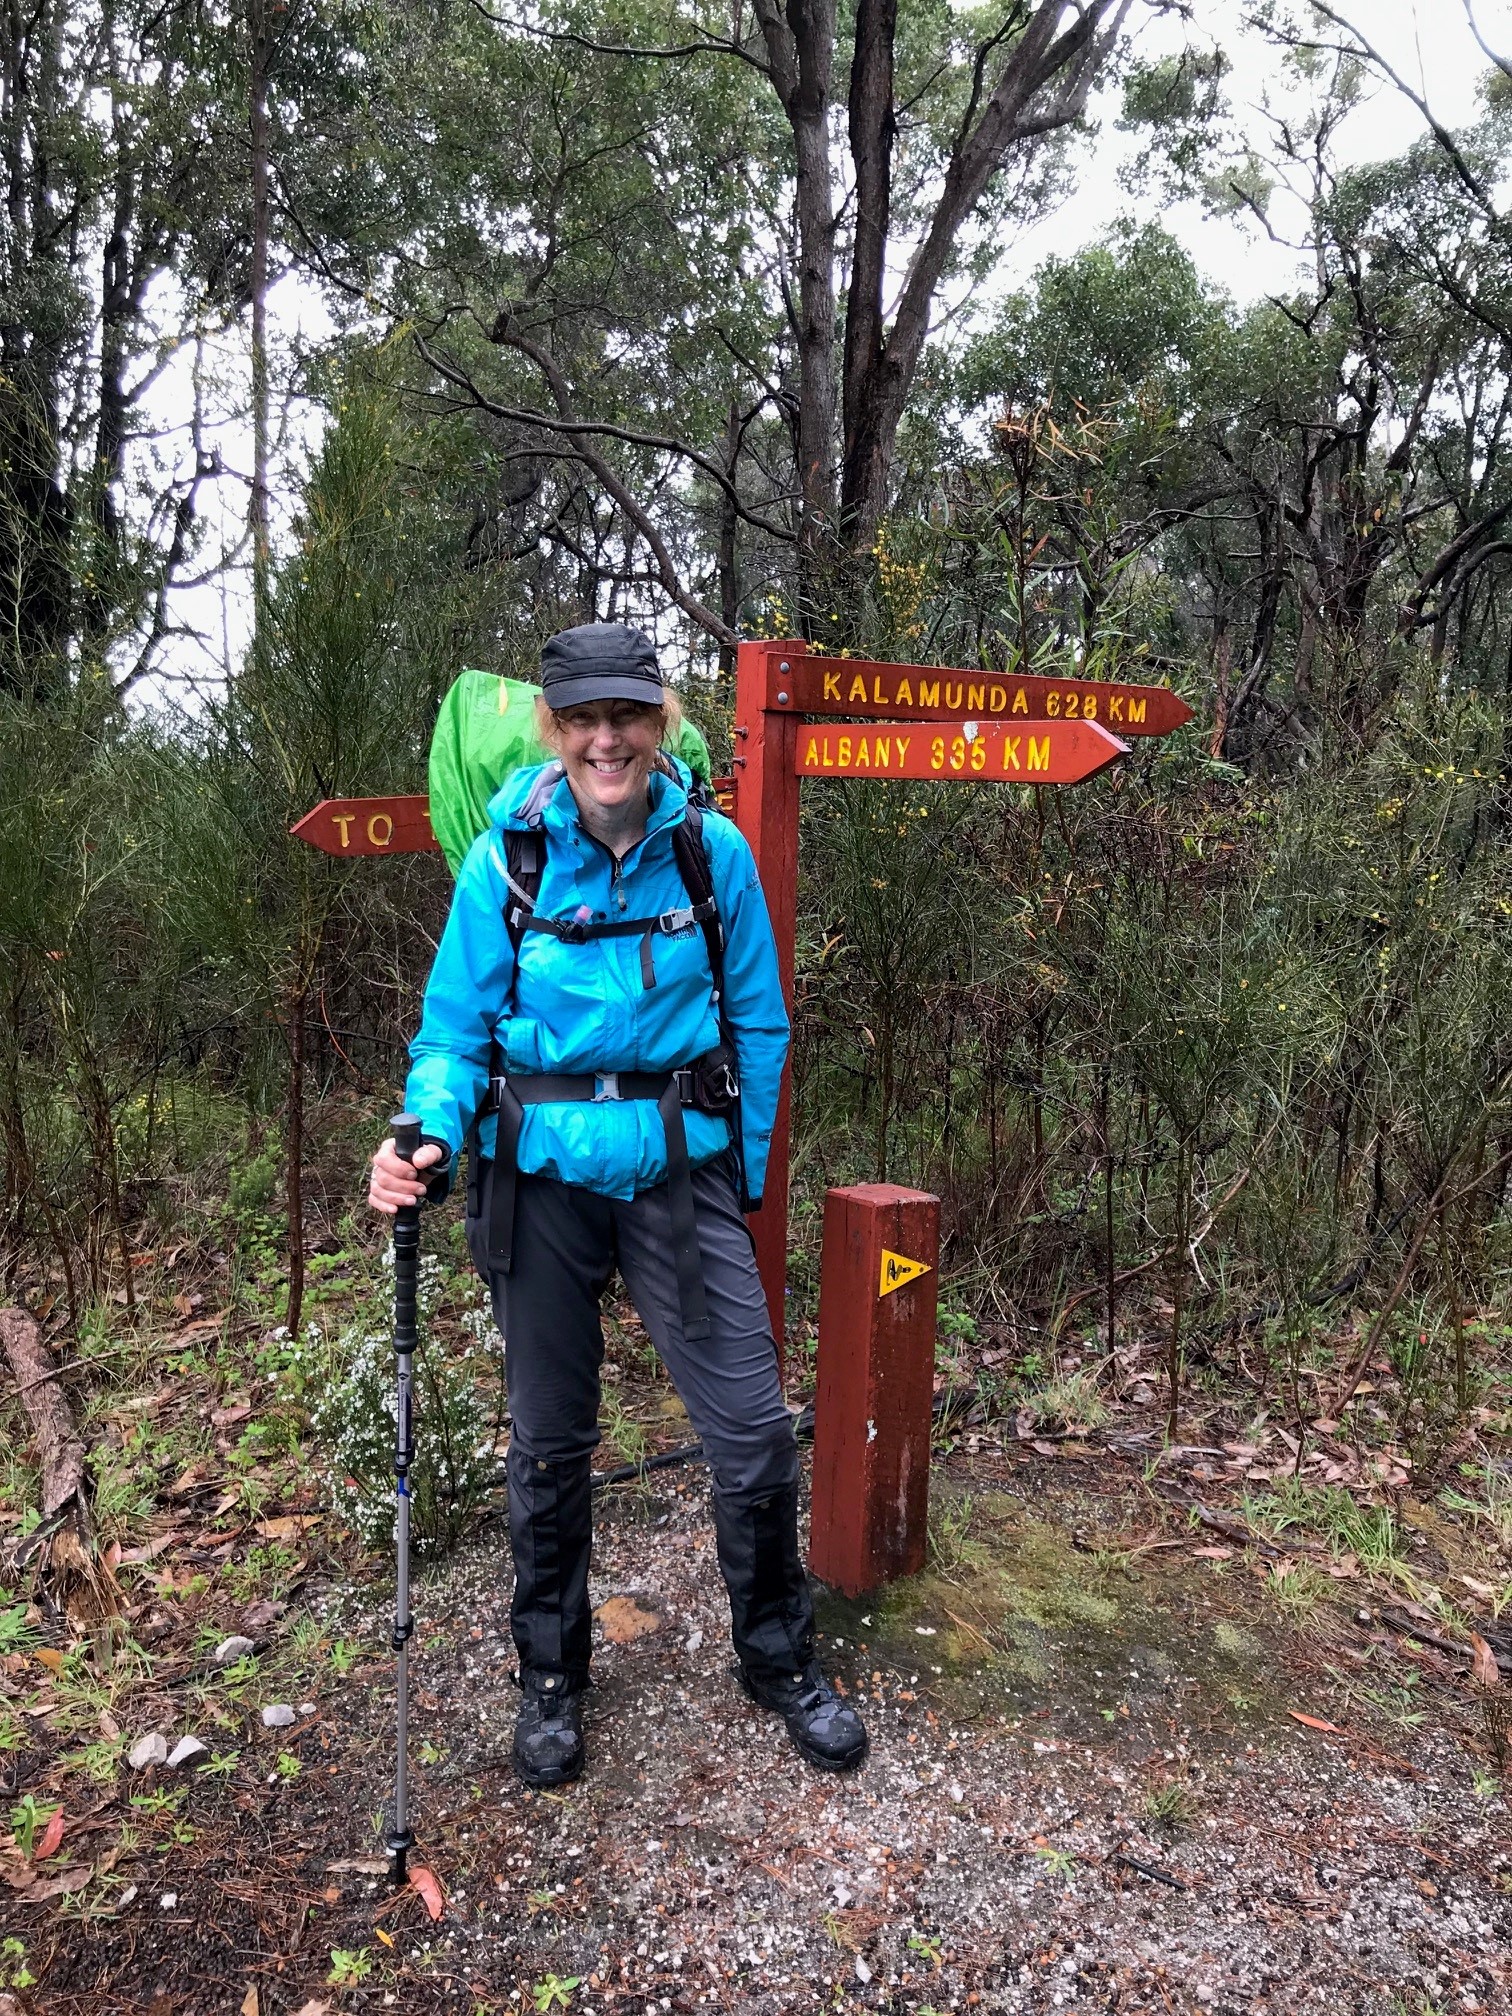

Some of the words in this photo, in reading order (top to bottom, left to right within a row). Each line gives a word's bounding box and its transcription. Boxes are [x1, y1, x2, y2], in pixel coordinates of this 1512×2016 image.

[823, 671, 1029, 714] KALAMUNDA
[1046, 690, 1098, 720] 628
[1109, 695, 1147, 723] KM
[804, 736, 911, 768] ALBANY
[930, 735, 987, 770] 335
[1003, 735, 1050, 771] KM
[331, 811, 393, 848] TO
